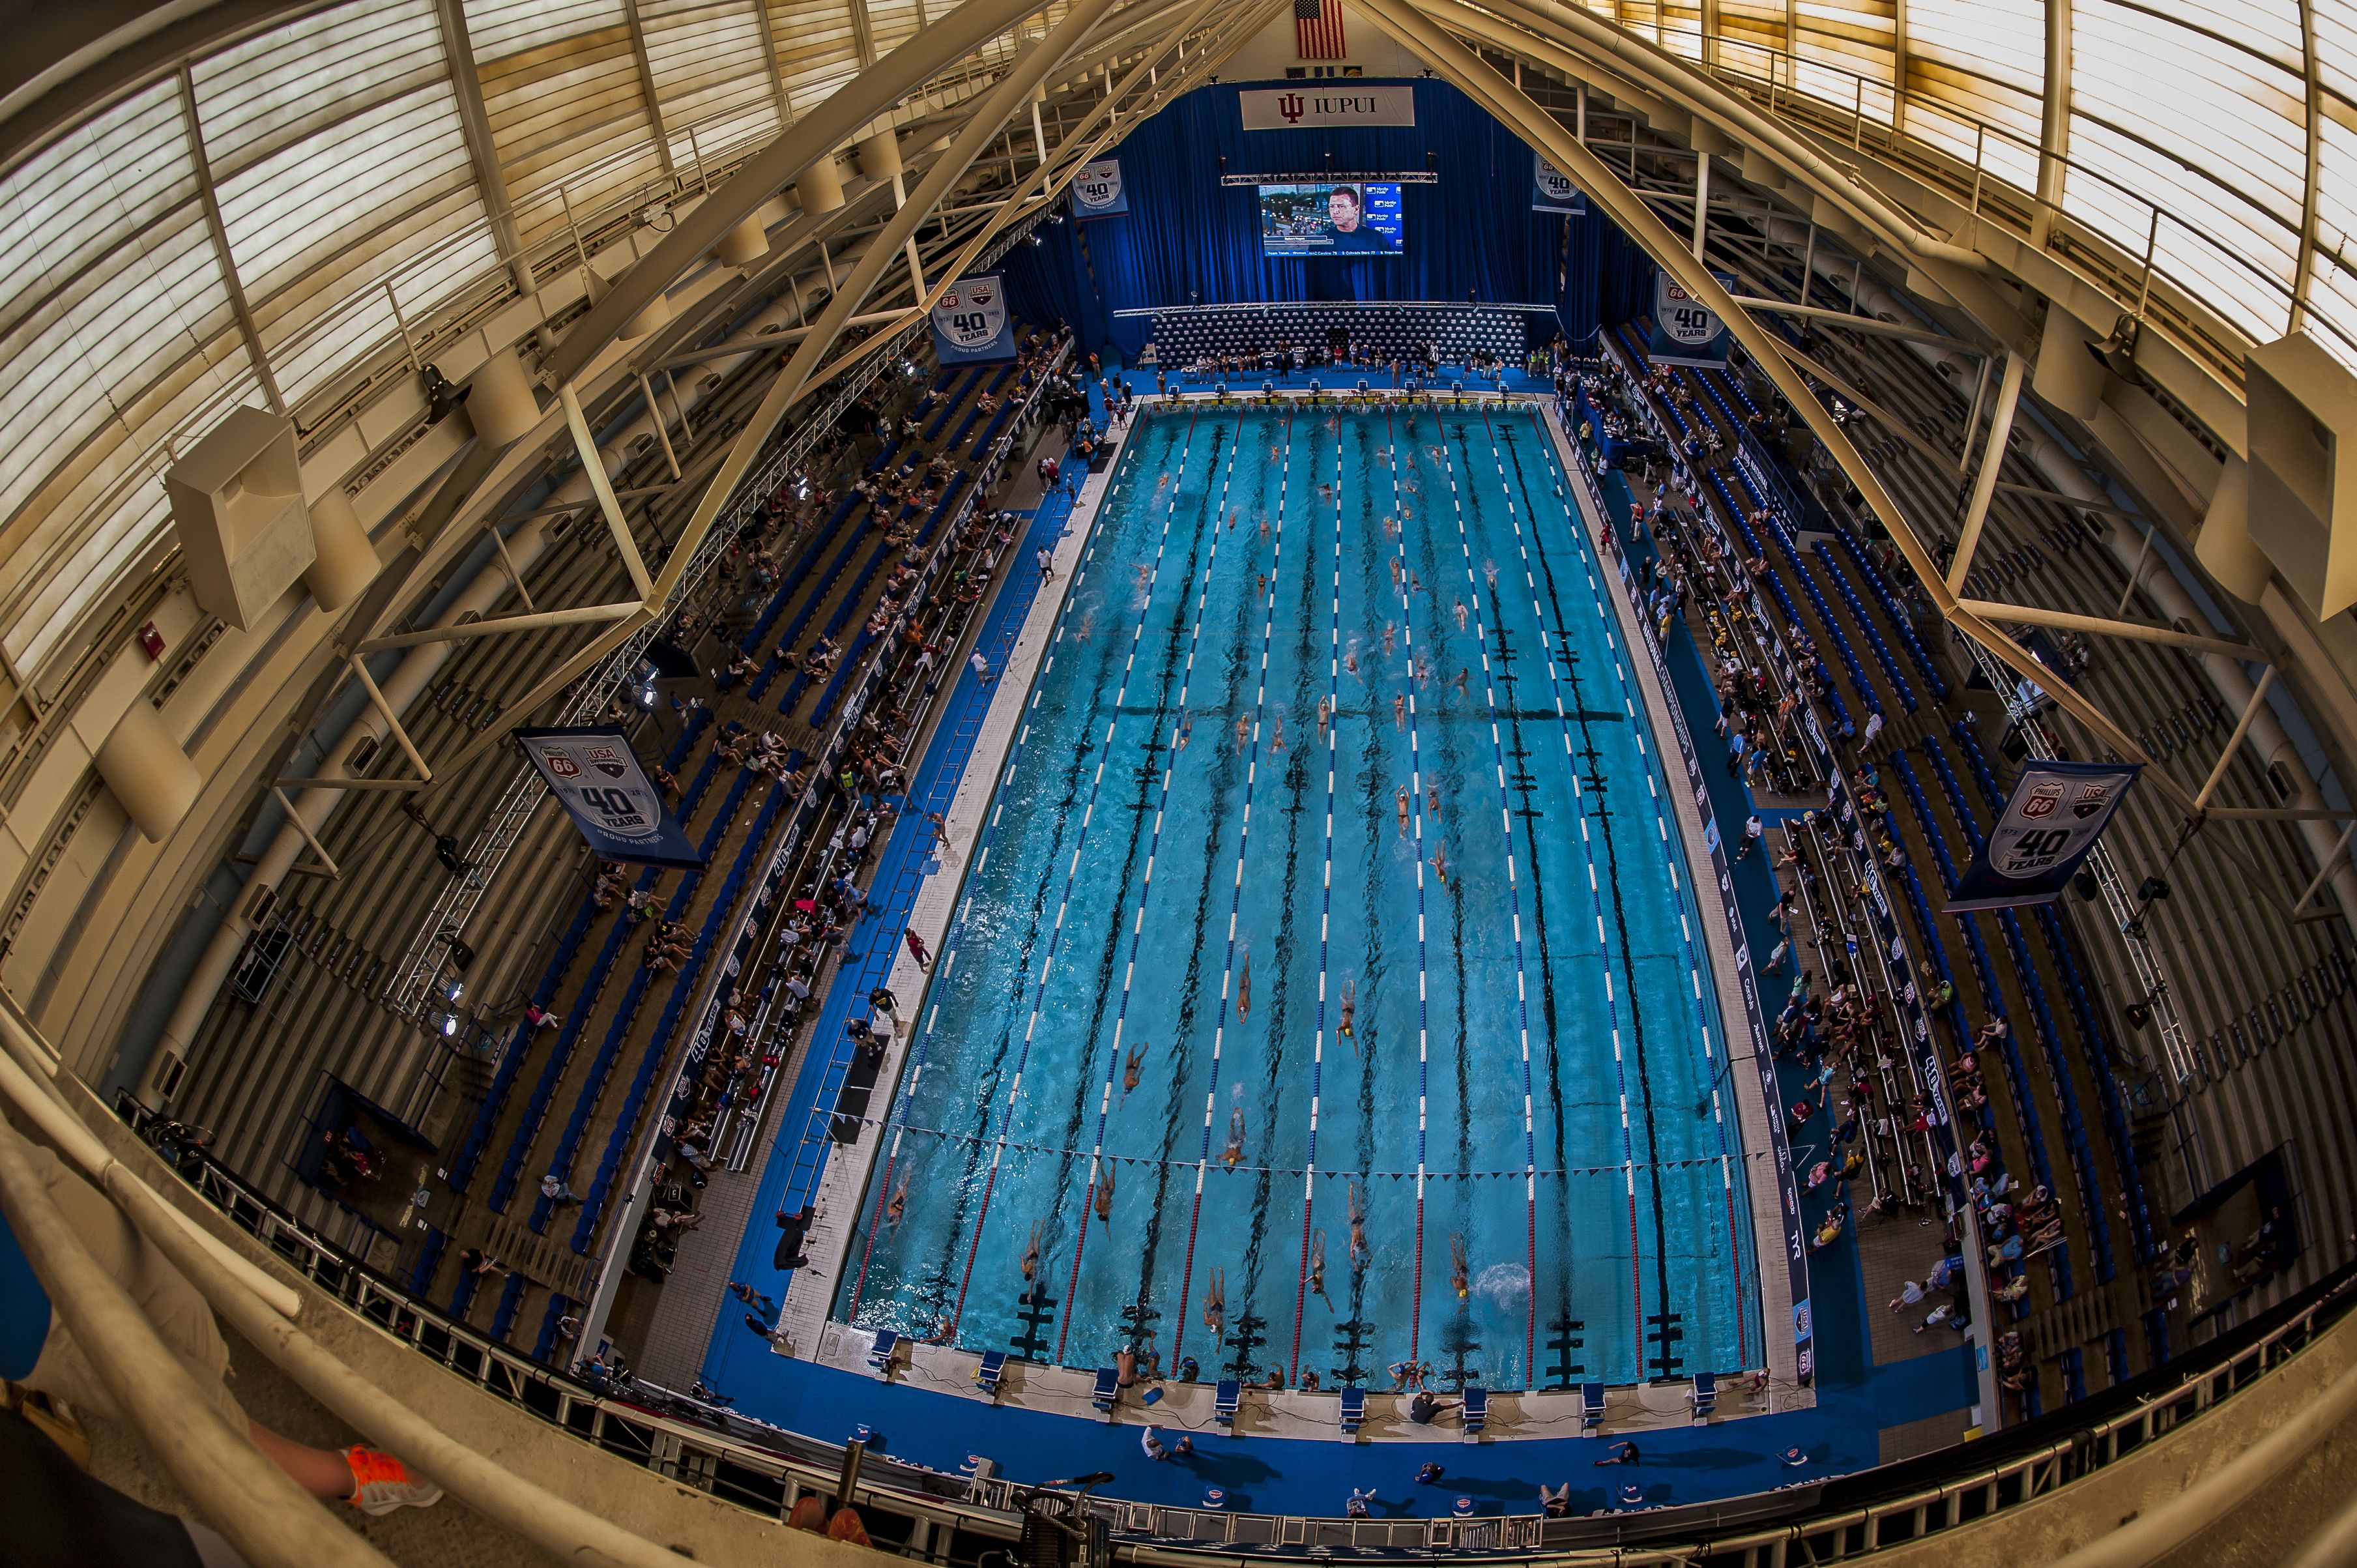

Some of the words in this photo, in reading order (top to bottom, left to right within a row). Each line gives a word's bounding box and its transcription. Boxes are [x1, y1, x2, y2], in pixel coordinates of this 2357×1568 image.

[1314, 97, 1377, 114] IUPUI
[1086, 182, 1108, 196] 40
[1547, 176, 1570, 189] 40
[1090, 194, 1110, 203] YEARS
[942, 297, 956, 306] 66
[1670, 289, 1685, 297] 66
[953, 312, 987, 332] 40
[1673, 307, 1708, 328] 40
[959, 330, 989, 342] YEARS
[951, 344, 969, 353] PROUD
[970, 340, 998, 353] PARTNERS
[1750, 460, 1768, 491] NATIONAL
[908, 595, 919, 615] 40
[1752, 594, 1761, 616] 40
[1643, 621, 1661, 672] NATIONAL
[1659, 667, 1689, 754] CHAMPIONSHIPS
[846, 706, 860, 731] 40
[1805, 708, 1816, 735] 40
[588, 750, 615, 759] USA
[553, 759, 573, 772] 66
[2034, 787, 2061, 796] PHILLIPS
[2085, 788, 2105, 798] USA
[579, 787, 636, 816] 40
[2027, 798, 2053, 812] 66
[601, 815, 644, 828] YEARS
[597, 829, 626, 843] PROUD
[629, 834, 663, 845] PARTNERS
[2014, 829, 2073, 857] 40
[774, 848, 789, 877] 40
[787, 828, 798, 854] YEARS
[2006, 856, 2055, 871] YEARS
[1865, 859, 1877, 890] 40
[1874, 885, 1886, 912] YEARS
[1744, 978, 1754, 1010] CeraVe
[691, 1030, 710, 1063] 40
[706, 1005, 717, 1033] YEARS
[1754, 1023, 1764, 1053] Marriott
[1926, 1056, 1939, 1091] 40
[1933, 1089, 1946, 1119] YEARS
[667, 1119, 674, 1133] 66
[1787, 1187, 1795, 1215] speedo
[1791, 1230, 1800, 1260] TYR
[1800, 1354, 1806, 1370] 66
